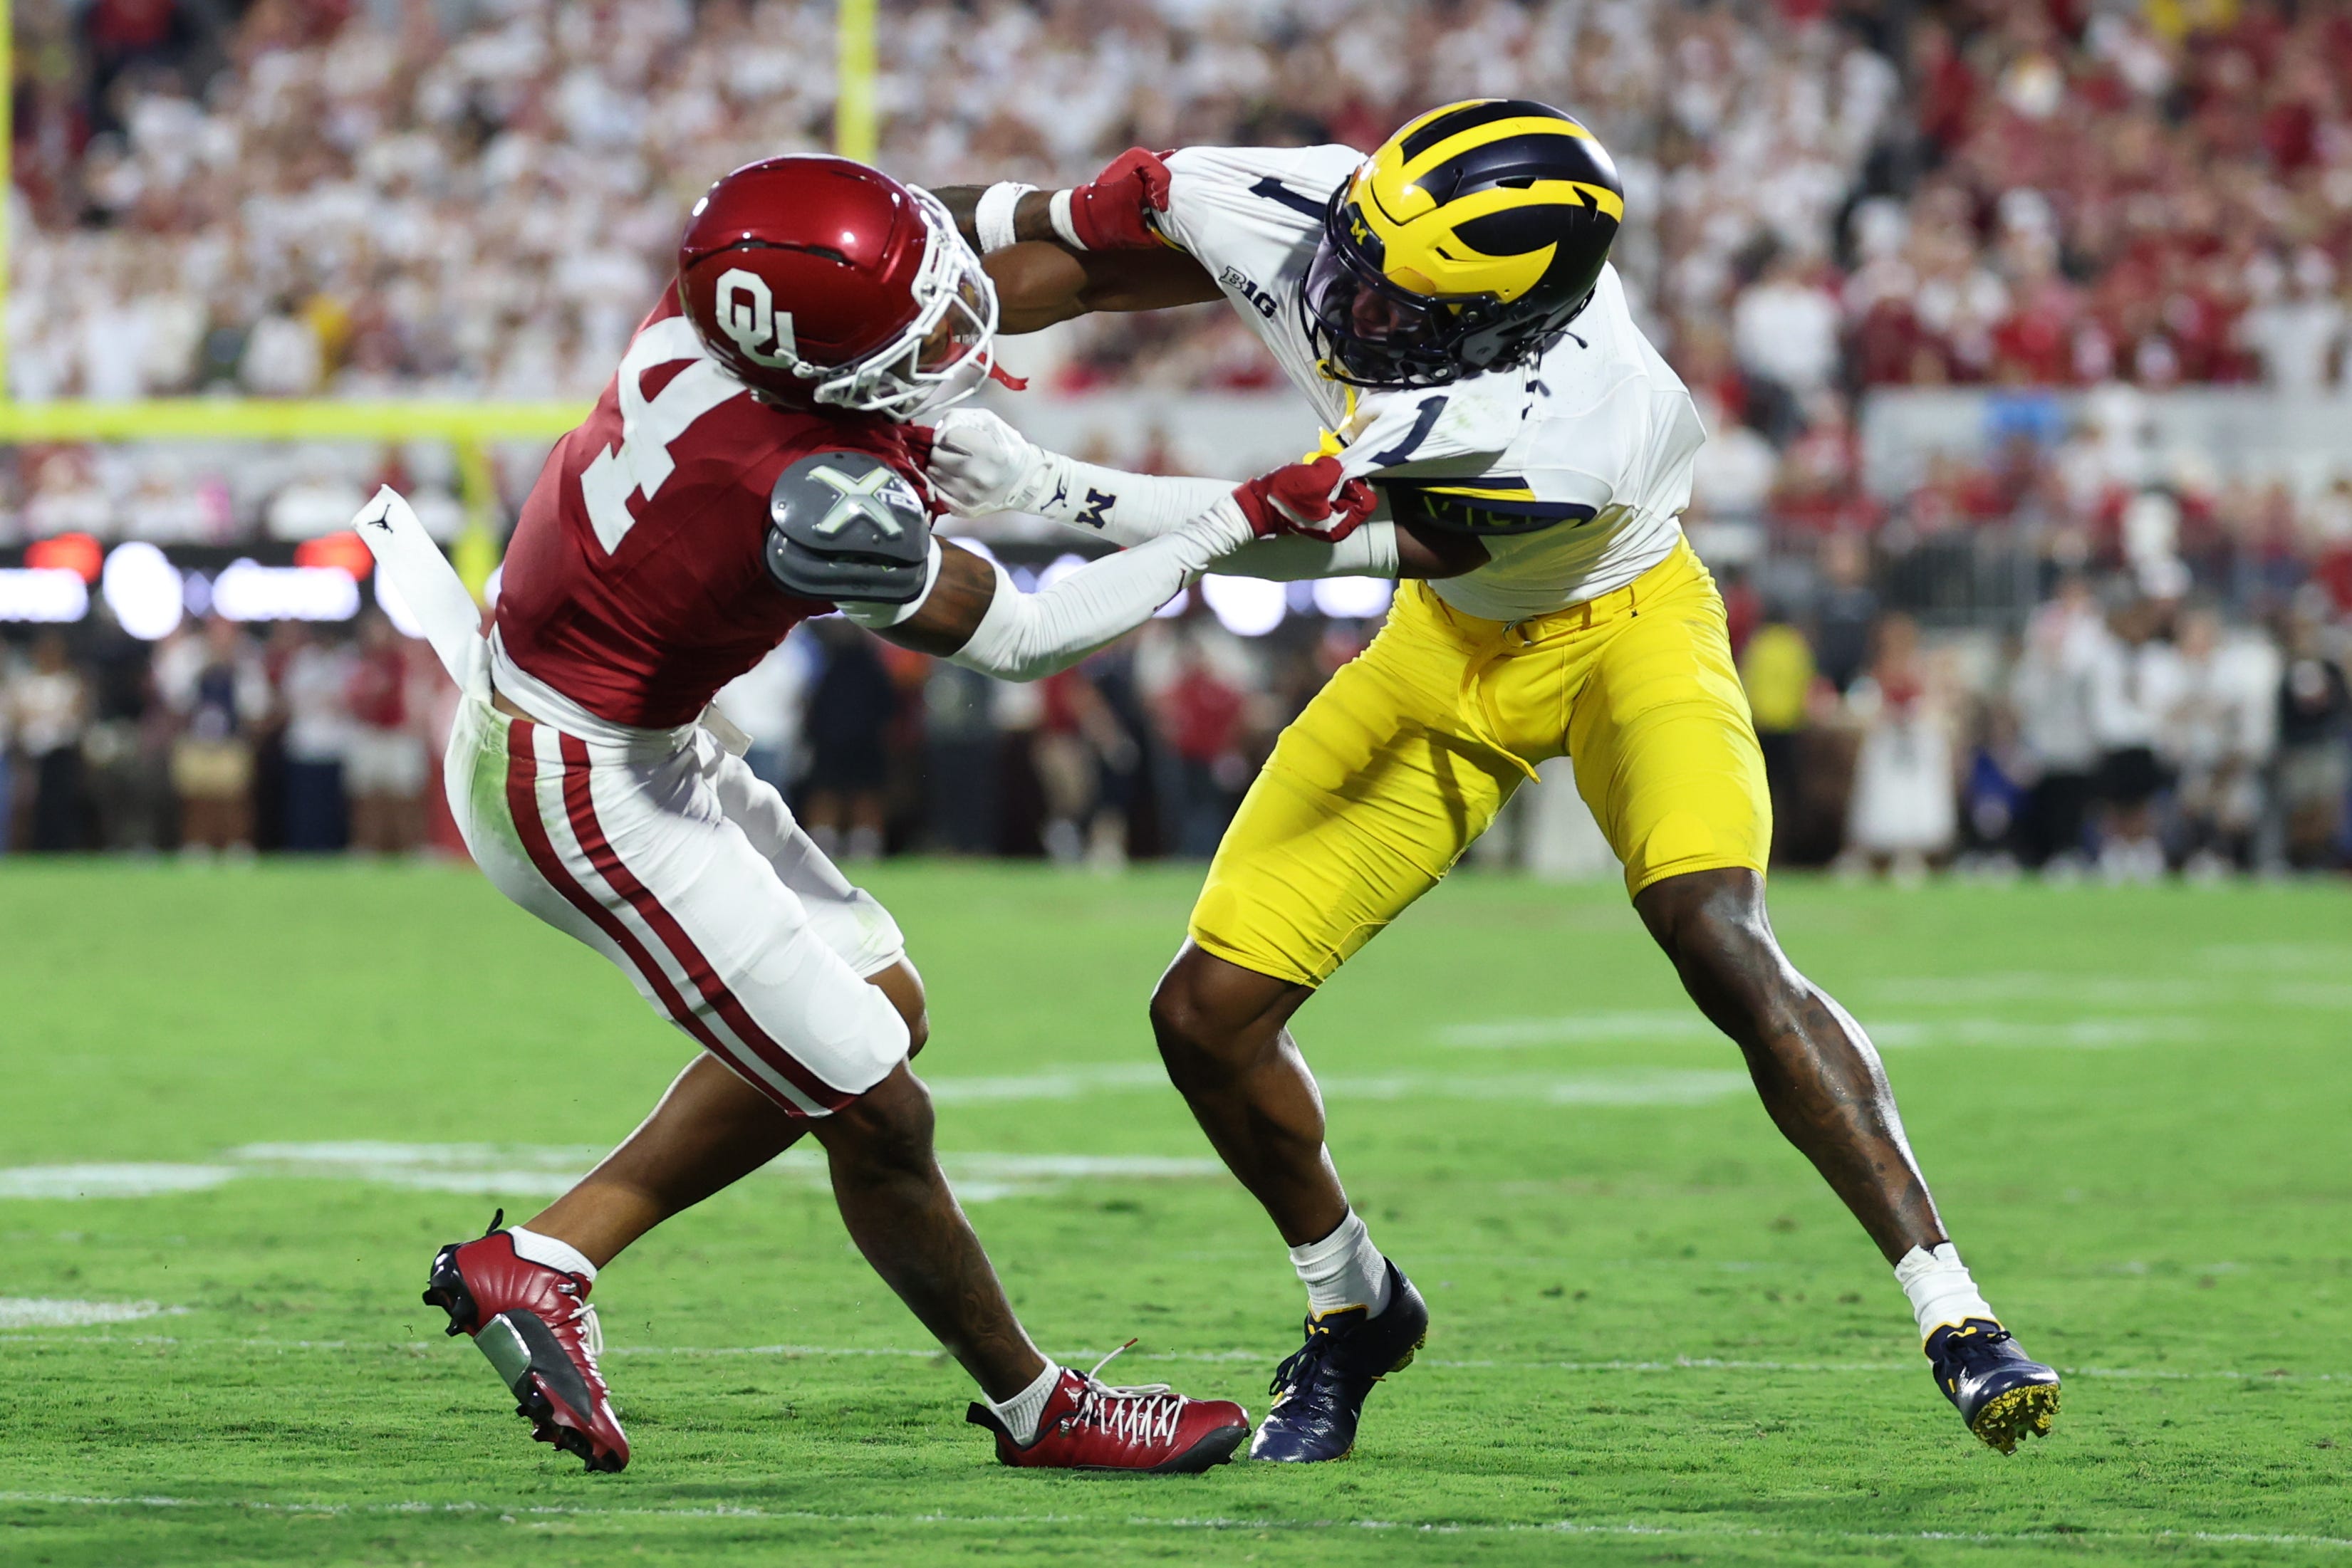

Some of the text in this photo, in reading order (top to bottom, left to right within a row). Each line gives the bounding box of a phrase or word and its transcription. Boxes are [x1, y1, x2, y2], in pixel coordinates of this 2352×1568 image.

[1350, 217, 1368, 246] M
[716, 268, 798, 368] OU
[581, 315, 746, 555] 4
[1369, 395, 1449, 467] 1
[1074, 487, 1117, 529] M
